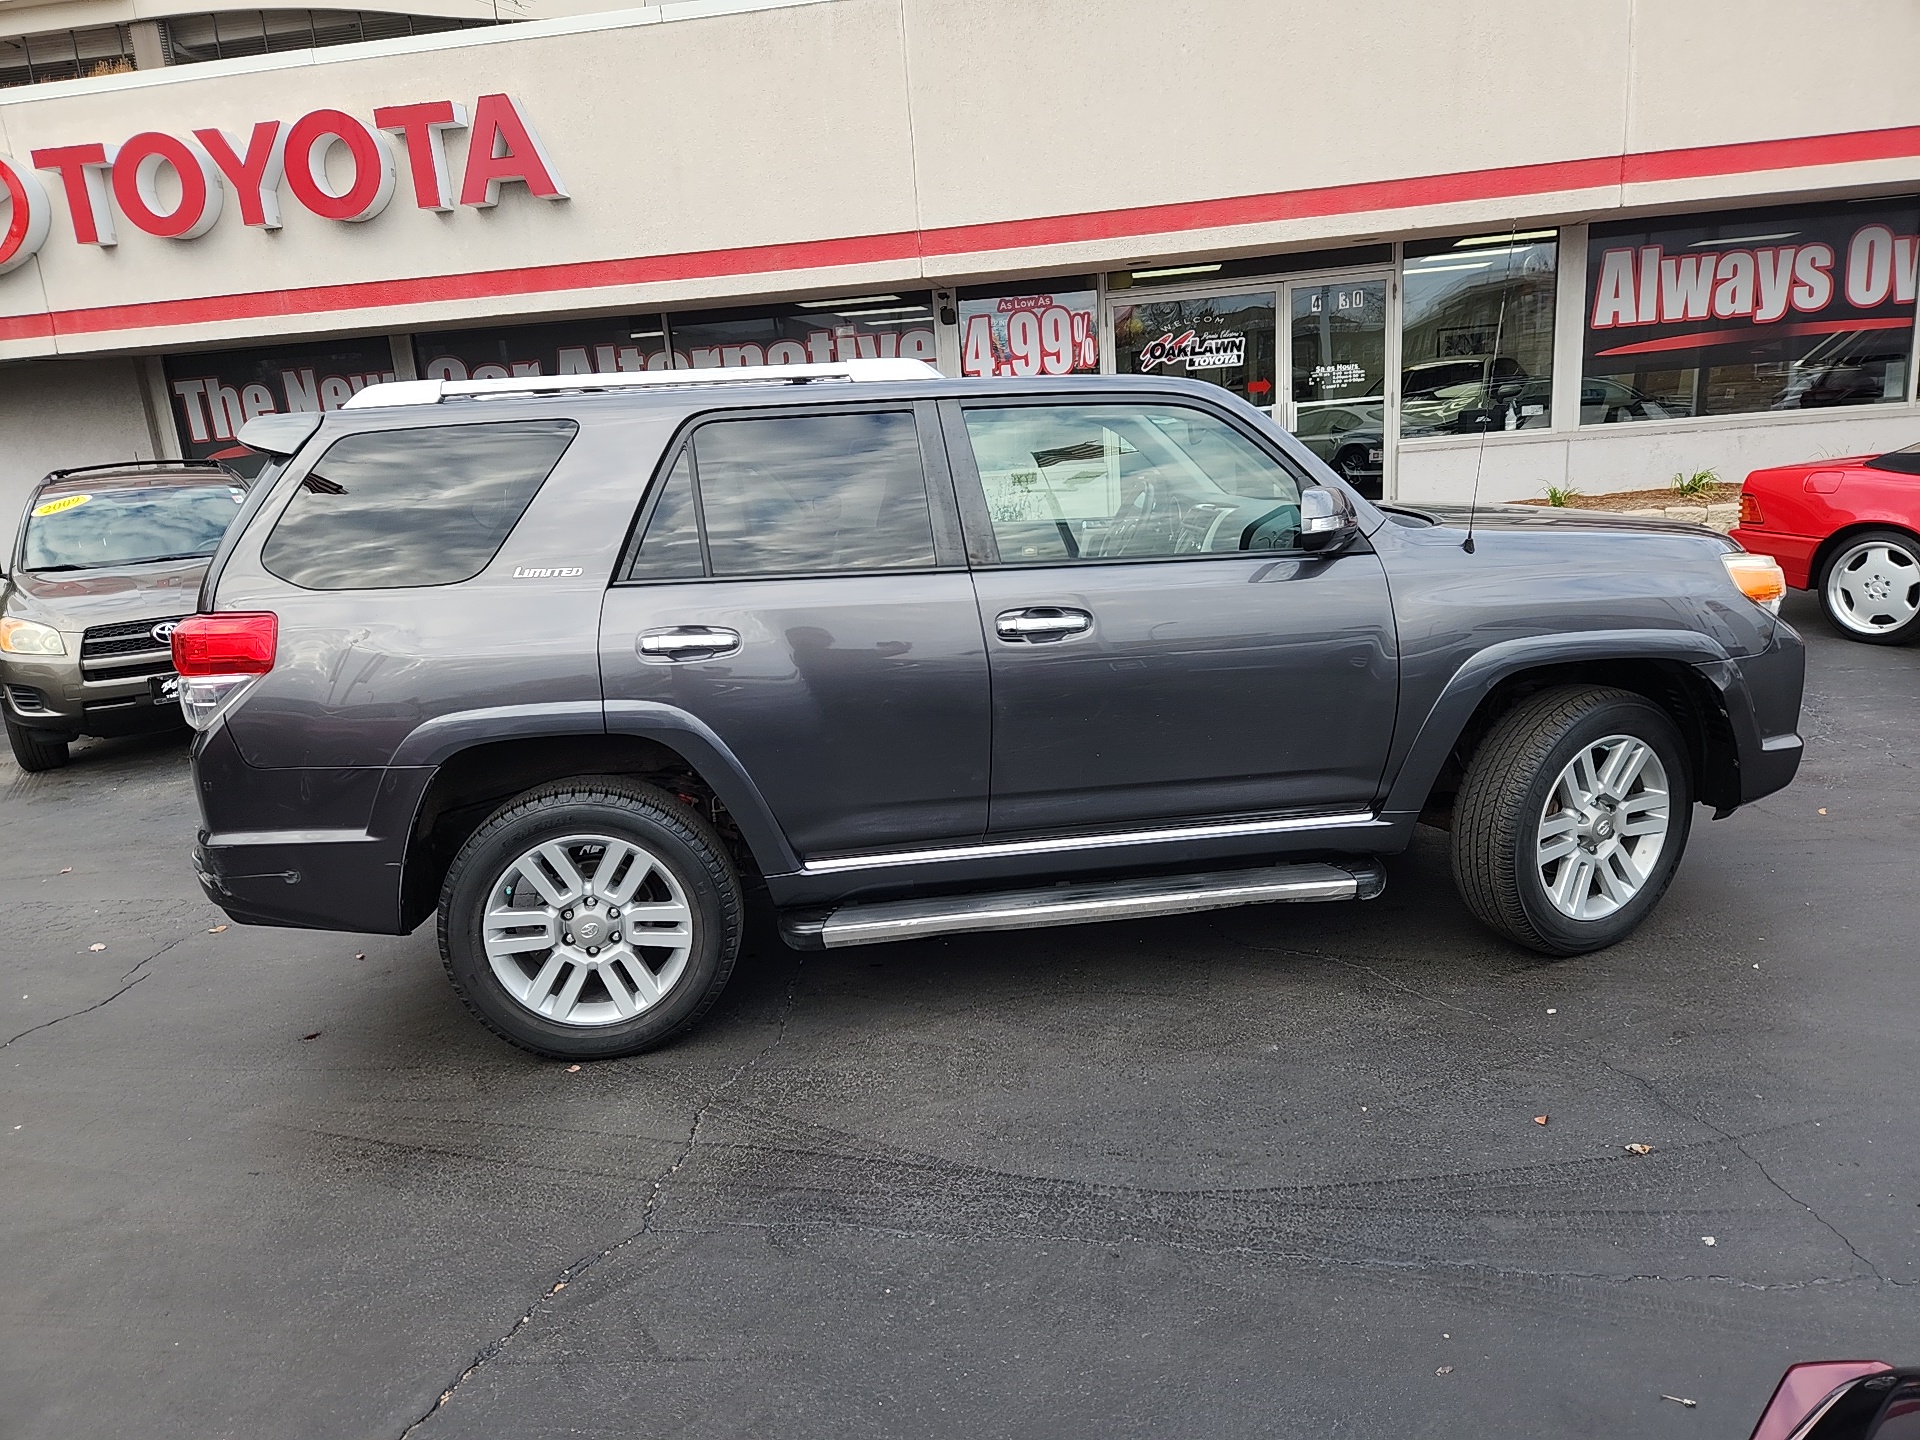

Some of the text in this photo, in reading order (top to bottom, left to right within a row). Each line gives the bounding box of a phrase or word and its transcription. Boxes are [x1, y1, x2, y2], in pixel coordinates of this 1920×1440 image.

[31, 93, 565, 246] TOYOTA
[1000, 301, 1012, 310] As
[1038, 296, 1050, 306] As
[1592, 245, 1834, 328] Always
[1193, 354, 1239, 367] TOYOTA
[173, 377, 275, 441] The
[41, 497, 80, 513] 2009
